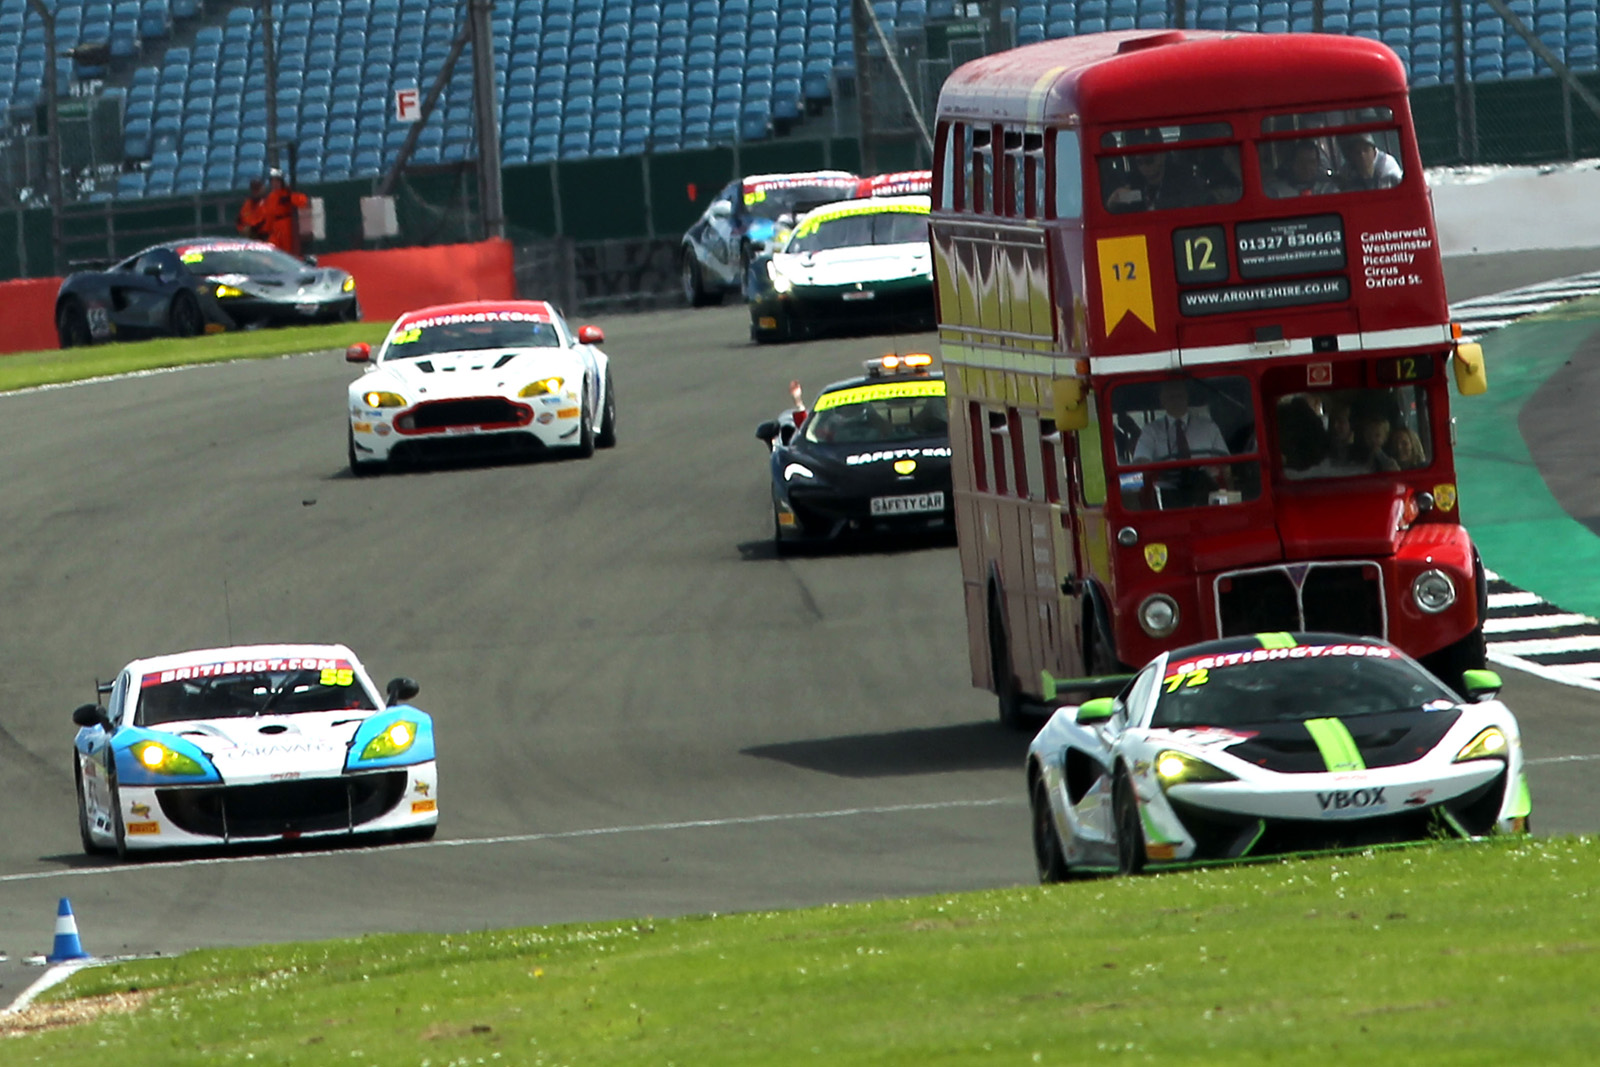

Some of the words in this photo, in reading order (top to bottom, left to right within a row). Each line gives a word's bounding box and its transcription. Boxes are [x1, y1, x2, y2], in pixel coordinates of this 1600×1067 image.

[397, 92, 416, 118] F
[1239, 236, 1283, 251] 01327
[1287, 230, 1341, 248] 830663
[1360, 227, 1427, 242] Camberwell
[1184, 236, 1217, 271] 12
[1362, 239, 1432, 254] Westminster
[1362, 252, 1415, 266] Piccadilly
[1112, 261, 1137, 282] 12
[1364, 266, 1399, 277] Circus
[1365, 275, 1406, 289] Oxford
[1408, 274, 1423, 285] St.
[1186, 281, 1340, 306] WWW.AROUTE2HIRE.CO.UK
[1396, 358, 1417, 379] 12
[846, 449, 920, 465] SAFETY
[873, 497, 917, 512] SAFETY
[920, 494, 941, 508] CAR
[160, 658, 337, 683] BRITISHGT.COM
[1177, 645, 1392, 675] BRITISHGT.COM
[319, 668, 354, 686] 55
[1163, 668, 1209, 693] 72
[1316, 786, 1387, 811] VBOX
